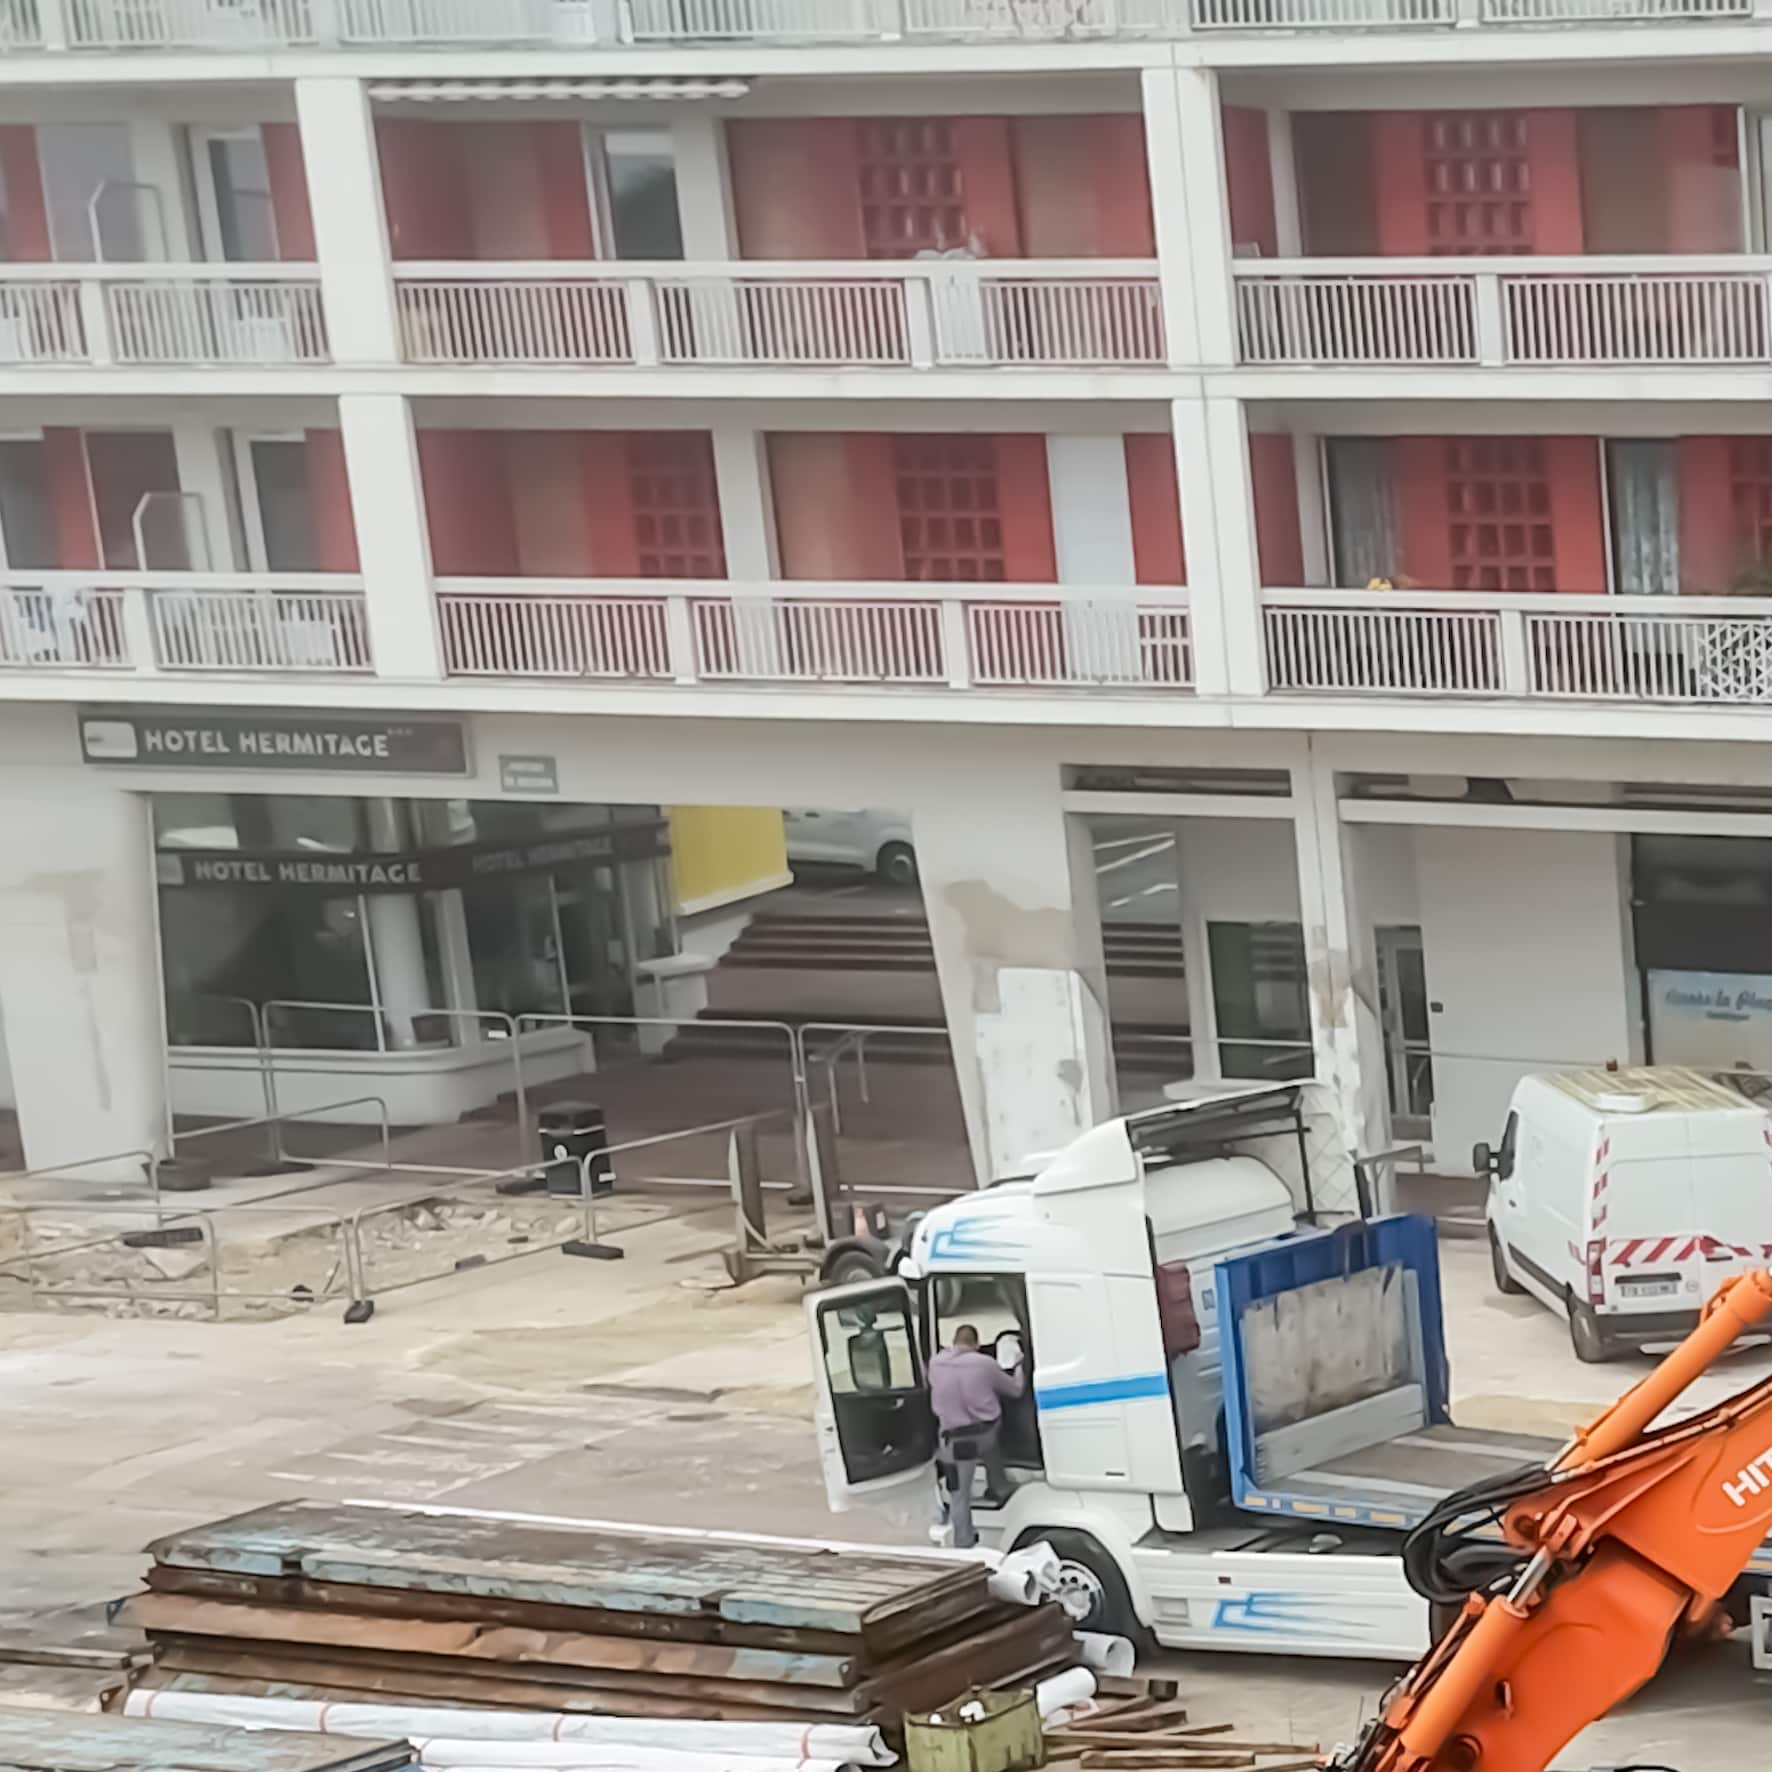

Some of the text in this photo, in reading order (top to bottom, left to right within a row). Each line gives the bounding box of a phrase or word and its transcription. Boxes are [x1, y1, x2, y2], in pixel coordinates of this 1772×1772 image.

[144, 729, 390, 759] HOTEL HERMITAGE
[194, 860, 422, 885] HOTEL HERMITAGE
